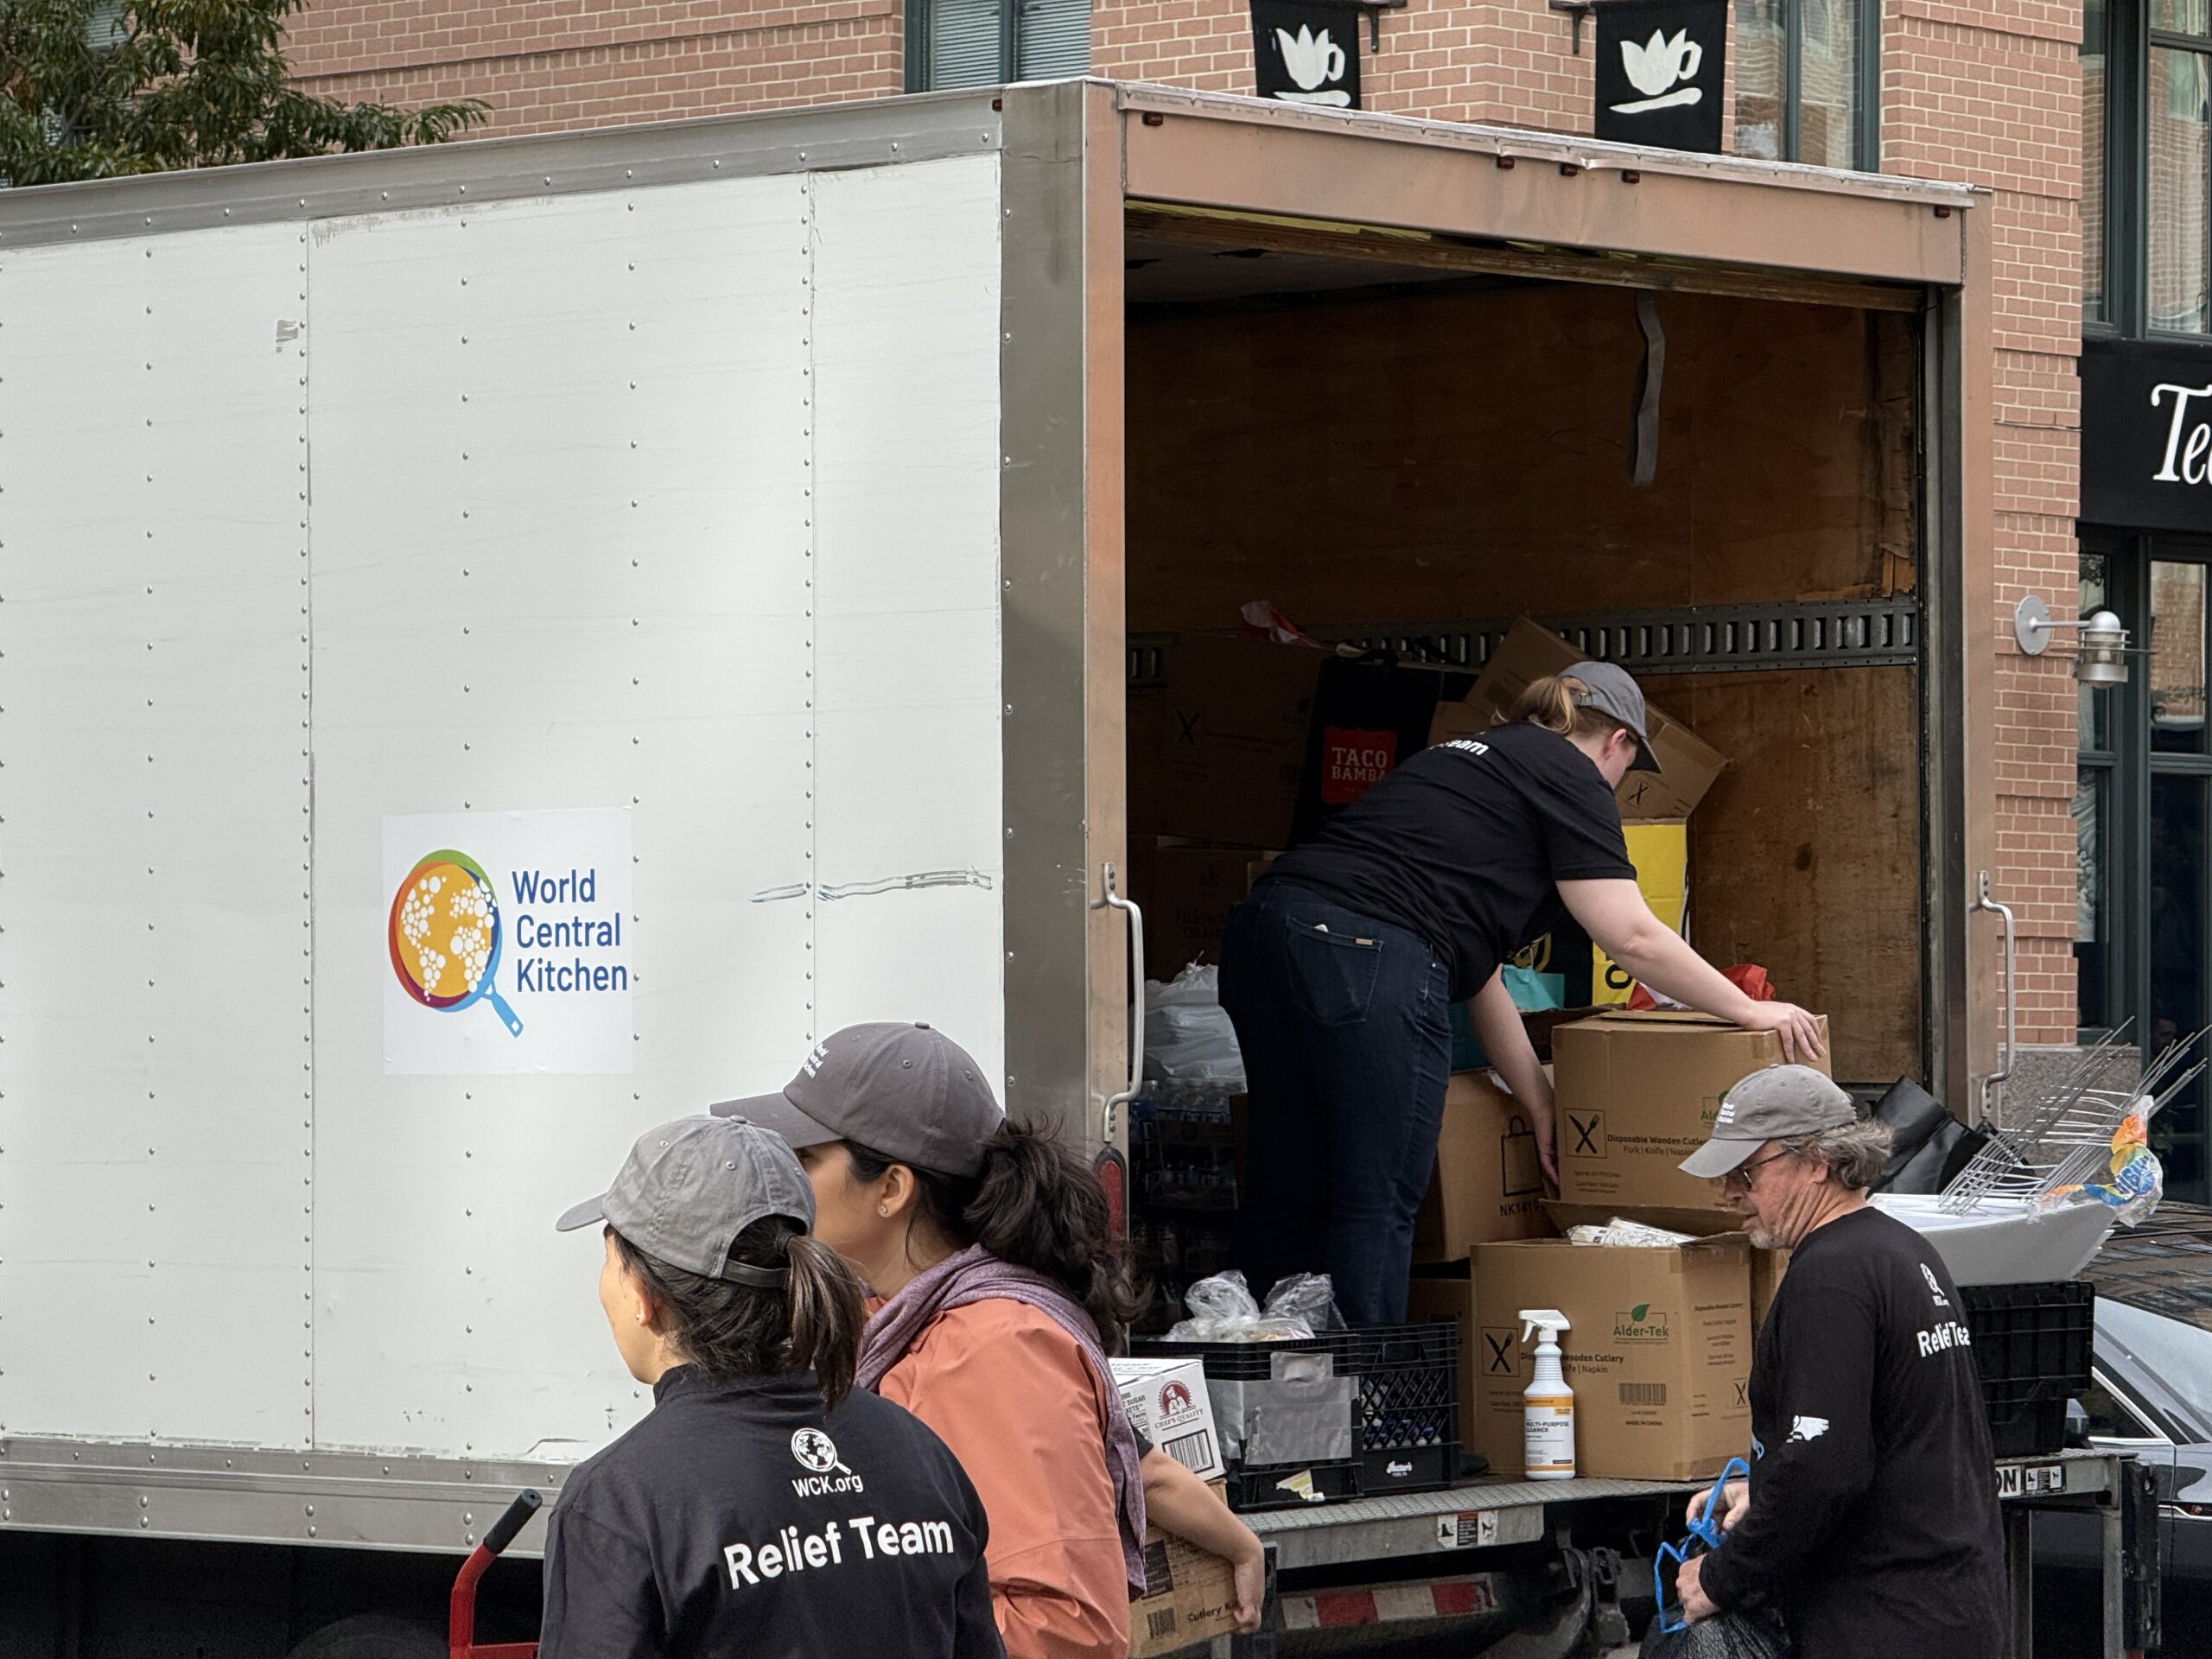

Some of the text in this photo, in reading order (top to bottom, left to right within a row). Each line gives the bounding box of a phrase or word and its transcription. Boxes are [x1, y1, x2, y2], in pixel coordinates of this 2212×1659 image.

[2151, 383, 2212, 486] Te
[1331, 746, 1389, 769] TACO
[512, 868, 595, 905] World
[517, 912, 620, 949] Central
[517, 957, 627, 993] Kitchen
[1606, 1134, 1649, 1145] Disposable
[1649, 1135, 1681, 1146] Wooden
[1623, 1145, 1641, 1155] Fork
[1645, 1146, 1664, 1156] Knife
[1613, 1325, 1669, 1337] Alder-Tek
[1948, 1321, 1971, 1346] Tea
[1560, 1353, 1624, 1363] Wooden Cutlery
[1560, 1363, 1609, 1375] nife Napkin
[1127, 1395, 1147, 1407] SUGAR
[1176, 1408, 1205, 1424] QUALITY
[791, 1473, 864, 1498] WCK.org
[723, 1516, 954, 1590] Relief Team
